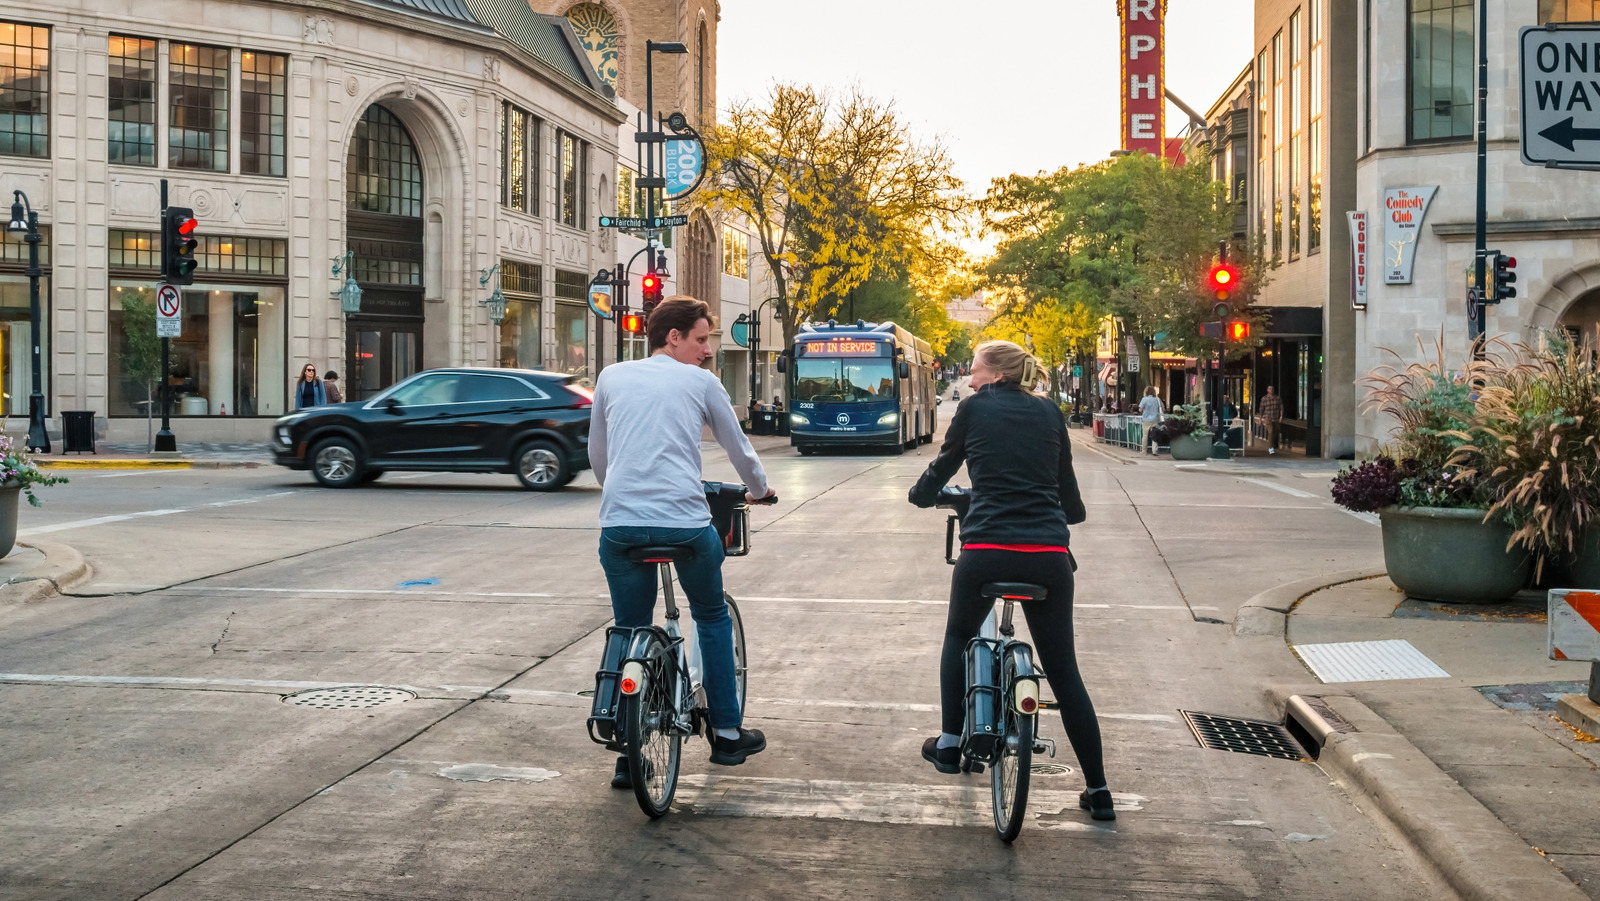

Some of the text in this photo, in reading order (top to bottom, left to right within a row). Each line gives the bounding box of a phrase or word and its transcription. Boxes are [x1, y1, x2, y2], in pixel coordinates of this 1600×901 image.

[1129, 0, 1156, 157] RPHE
[666, 148, 678, 185] BLOCK
[678, 140, 697, 185] 200
[1398, 190, 1408, 198] The
[1386, 195, 1424, 211] Comedy
[615, 217, 641, 227] Fairchild
[664, 217, 682, 226] Dayton
[1392, 210, 1413, 223] Club
[1357, 221, 1365, 286] COMEDY
[807, 342, 876, 352] NOT IN SERVICE
[1129, 363, 1138, 371] 15
